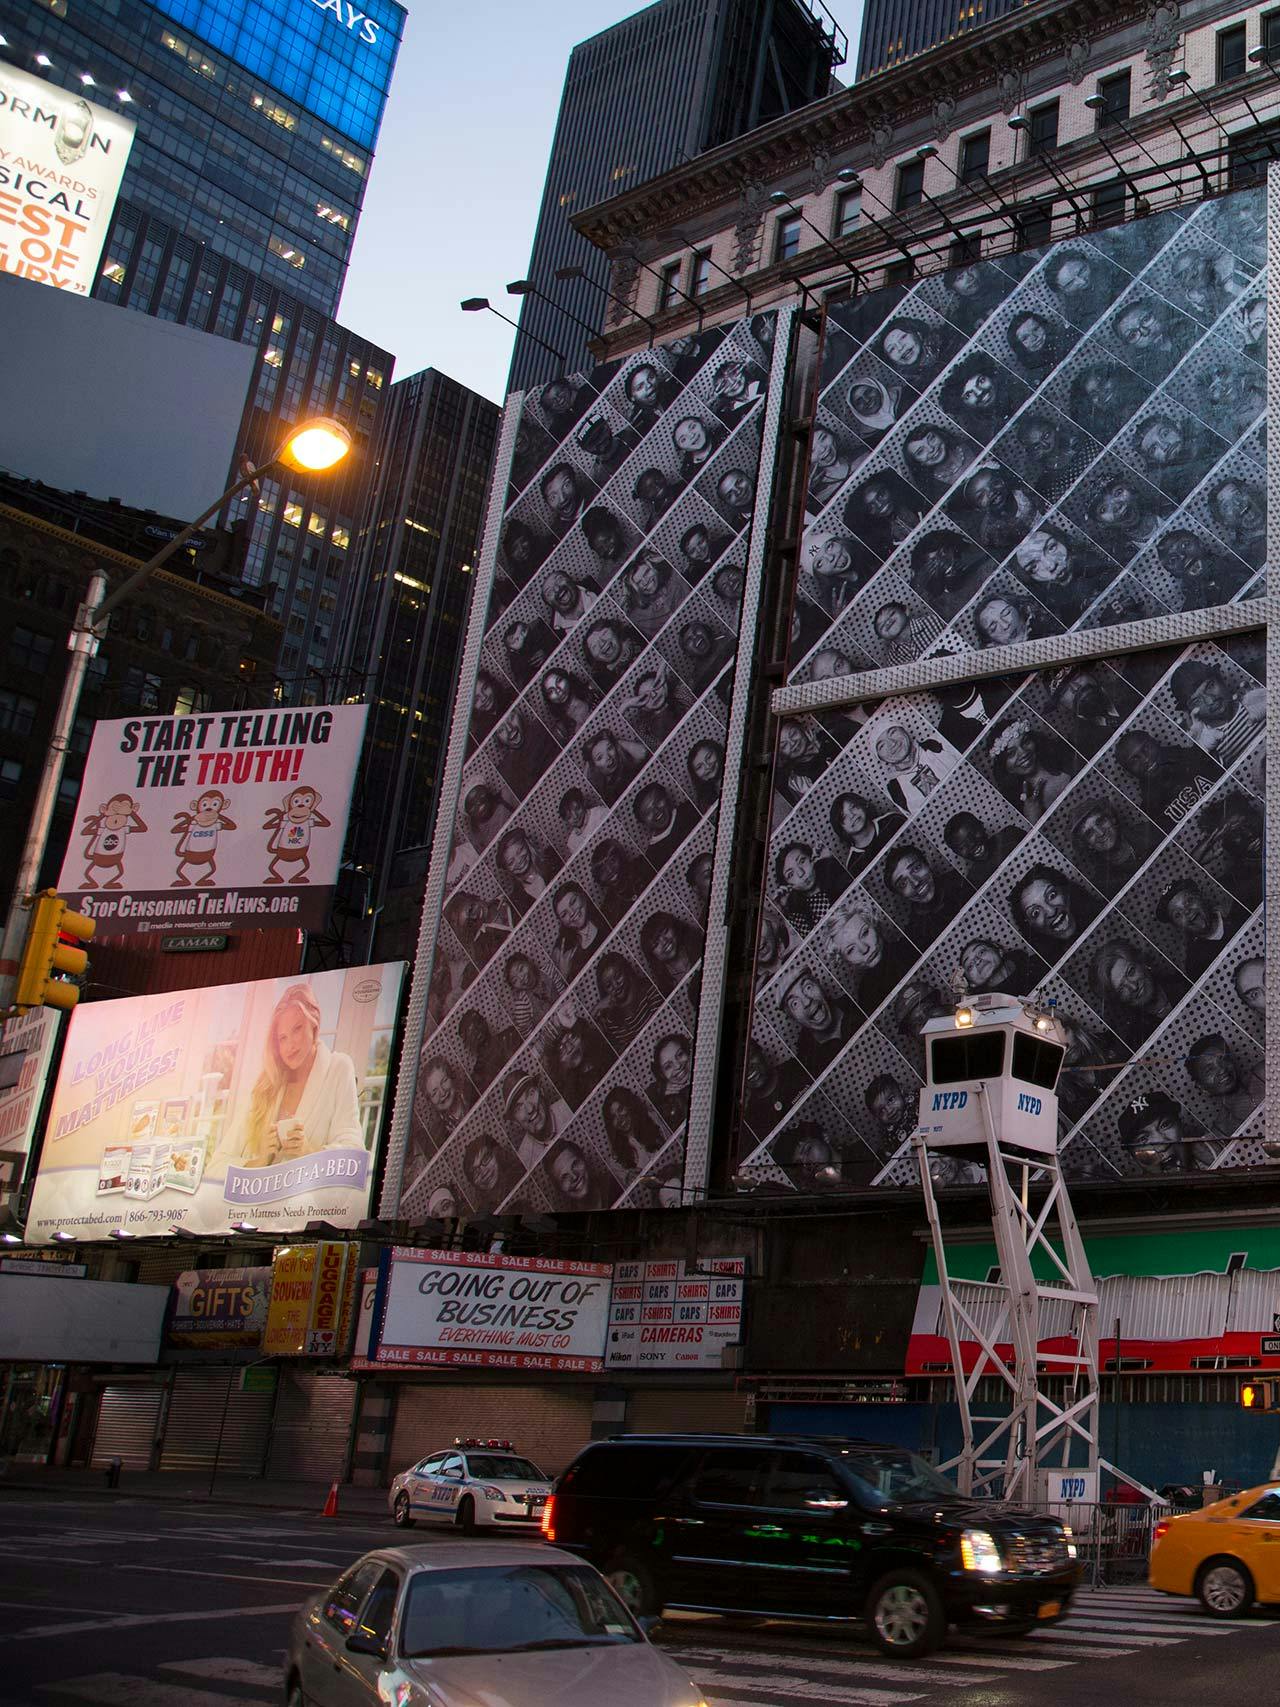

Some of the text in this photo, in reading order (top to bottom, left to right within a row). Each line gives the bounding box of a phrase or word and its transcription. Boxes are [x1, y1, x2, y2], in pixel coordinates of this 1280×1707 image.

[312, 0, 381, 45] AYS
[12, 155, 99, 200] AWARDS
[20, 237, 80, 271] OF
[120, 711, 334, 753] START TELLING
[136, 748, 305, 788] THE TRUTH!
[1164, 775, 1216, 823] USA
[104, 838, 118, 846] abc
[151, 920, 233, 930] media research center
[168, 937, 220, 948] LAMAR
[71, 1000, 185, 1085] LONG LIVE
[97, 1038, 156, 1092] YOUR
[55, 1047, 181, 1140] MATTRESS!
[932, 1091, 968, 1112] NYPD
[1017, 1092, 1042, 1116] NYPD
[37, 1209, 188, 1229] www.protectabed.com 866-793-9087
[228, 1206, 347, 1220] Every Mattress Needs Protection
[394, 1248, 425, 1259] SALE
[431, 1251, 461, 1262] SALE
[467, 1254, 496, 1265] SALE
[502, 1257, 530, 1268] SALE
[536, 1259, 564, 1270] SALE
[569, 1262, 598, 1273] SALE
[647, 1263, 677, 1277] T-SHIRTS
[619, 1265, 638, 1278] CAPS
[317, 1244, 340, 1329] LUGGAGE
[418, 1270, 601, 1306] GOING OUT OF
[613, 1286, 642, 1299] T-SHIRTS
[649, 1285, 669, 1298] CAPS
[677, 1284, 708, 1298] T-SHIRTS
[716, 1284, 737, 1297] CAPS
[191, 1286, 255, 1317] GIFTS
[436, 1300, 578, 1331] BUSINESS
[615, 1307, 635, 1321] CAPS
[642, 1307, 672, 1320] T-SHIRTS
[680, 1306, 700, 1319] CAPS
[709, 1306, 740, 1319] T-SHIRTS
[438, 1327, 571, 1348] EVERYTHING MUST GO
[640, 1327, 704, 1343] CAMERAS
[380, 1349, 410, 1360] SALE
[416, 1351, 446, 1362] SALE
[452, 1353, 482, 1364] SALE
[488, 1355, 518, 1366] SALE
[523, 1357, 551, 1368] SALE
[557, 1359, 585, 1370] SALE
[610, 1352, 632, 1361] Nikon
[640, 1352, 666, 1361] SONY
[675, 1352, 699, 1361] Canon
[1060, 1478, 1086, 1498] NYPD
